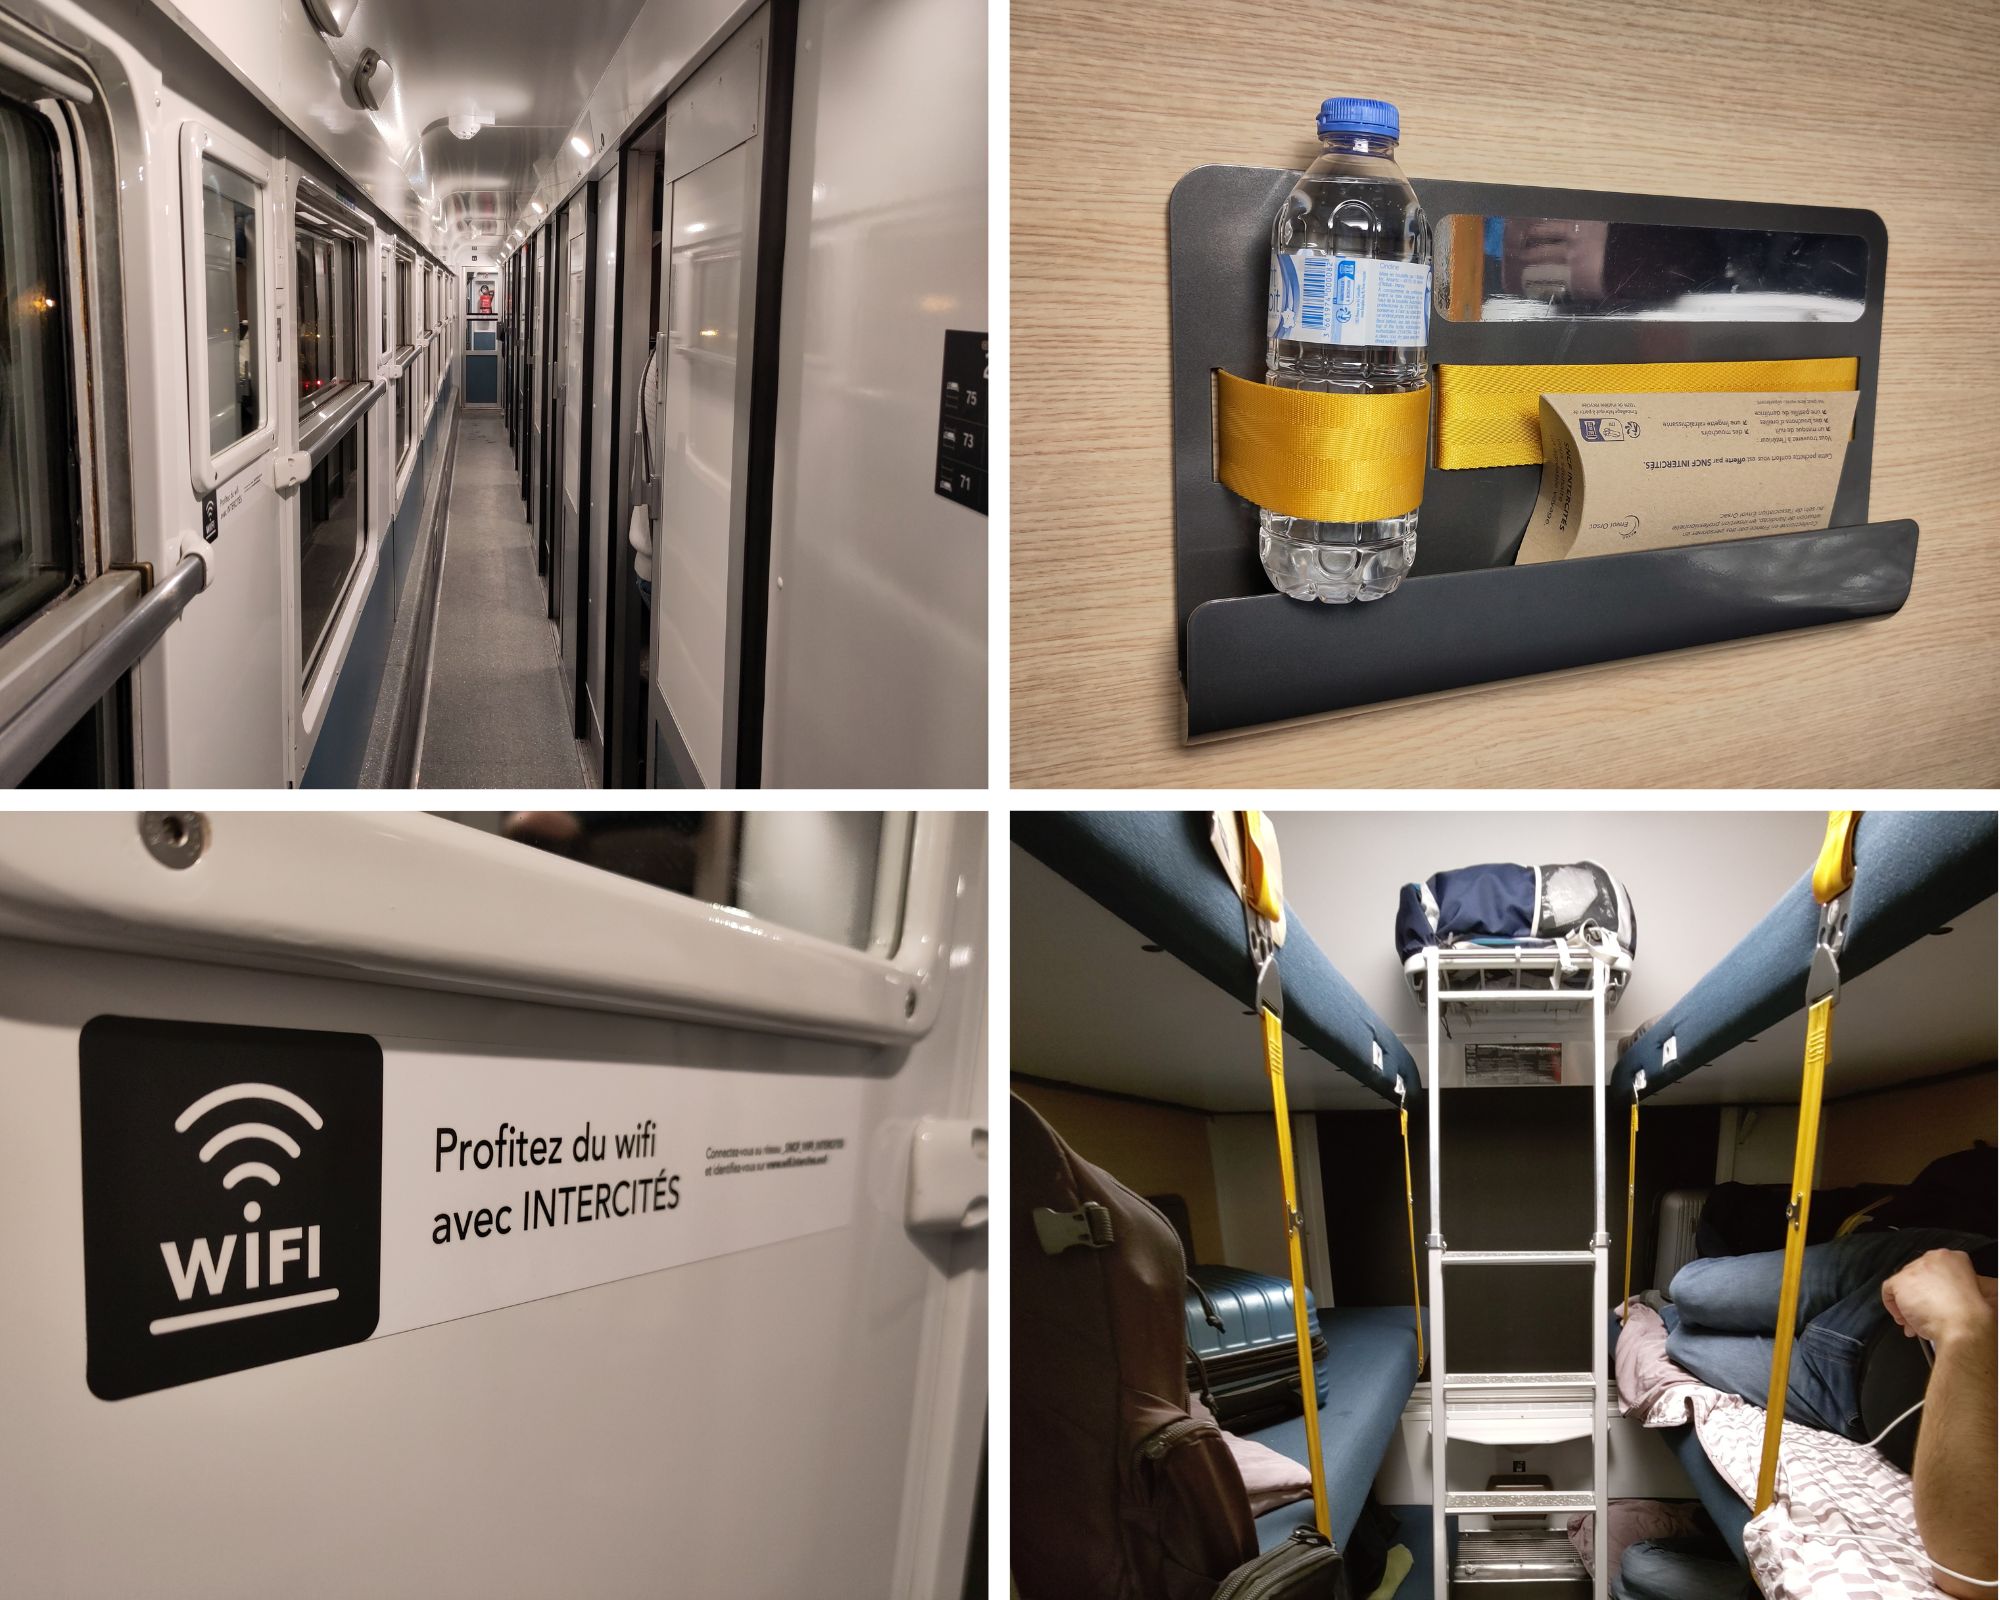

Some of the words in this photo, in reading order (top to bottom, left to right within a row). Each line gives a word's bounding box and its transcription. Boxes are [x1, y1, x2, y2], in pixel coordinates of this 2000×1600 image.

[966, 390, 977, 406] 75
[963, 432, 974, 448] 73
[1644, 460, 1690, 470] INTERCITÉS.
[1691, 459, 1711, 467] SNCF
[960, 474, 970, 490] 71
[436, 1123, 562, 1172] Profitez
[573, 1121, 605, 1162] du
[615, 1120, 656, 1159] wifi
[433, 1205, 512, 1244] avec
[524, 1169, 680, 1230] INTERCITÉS
